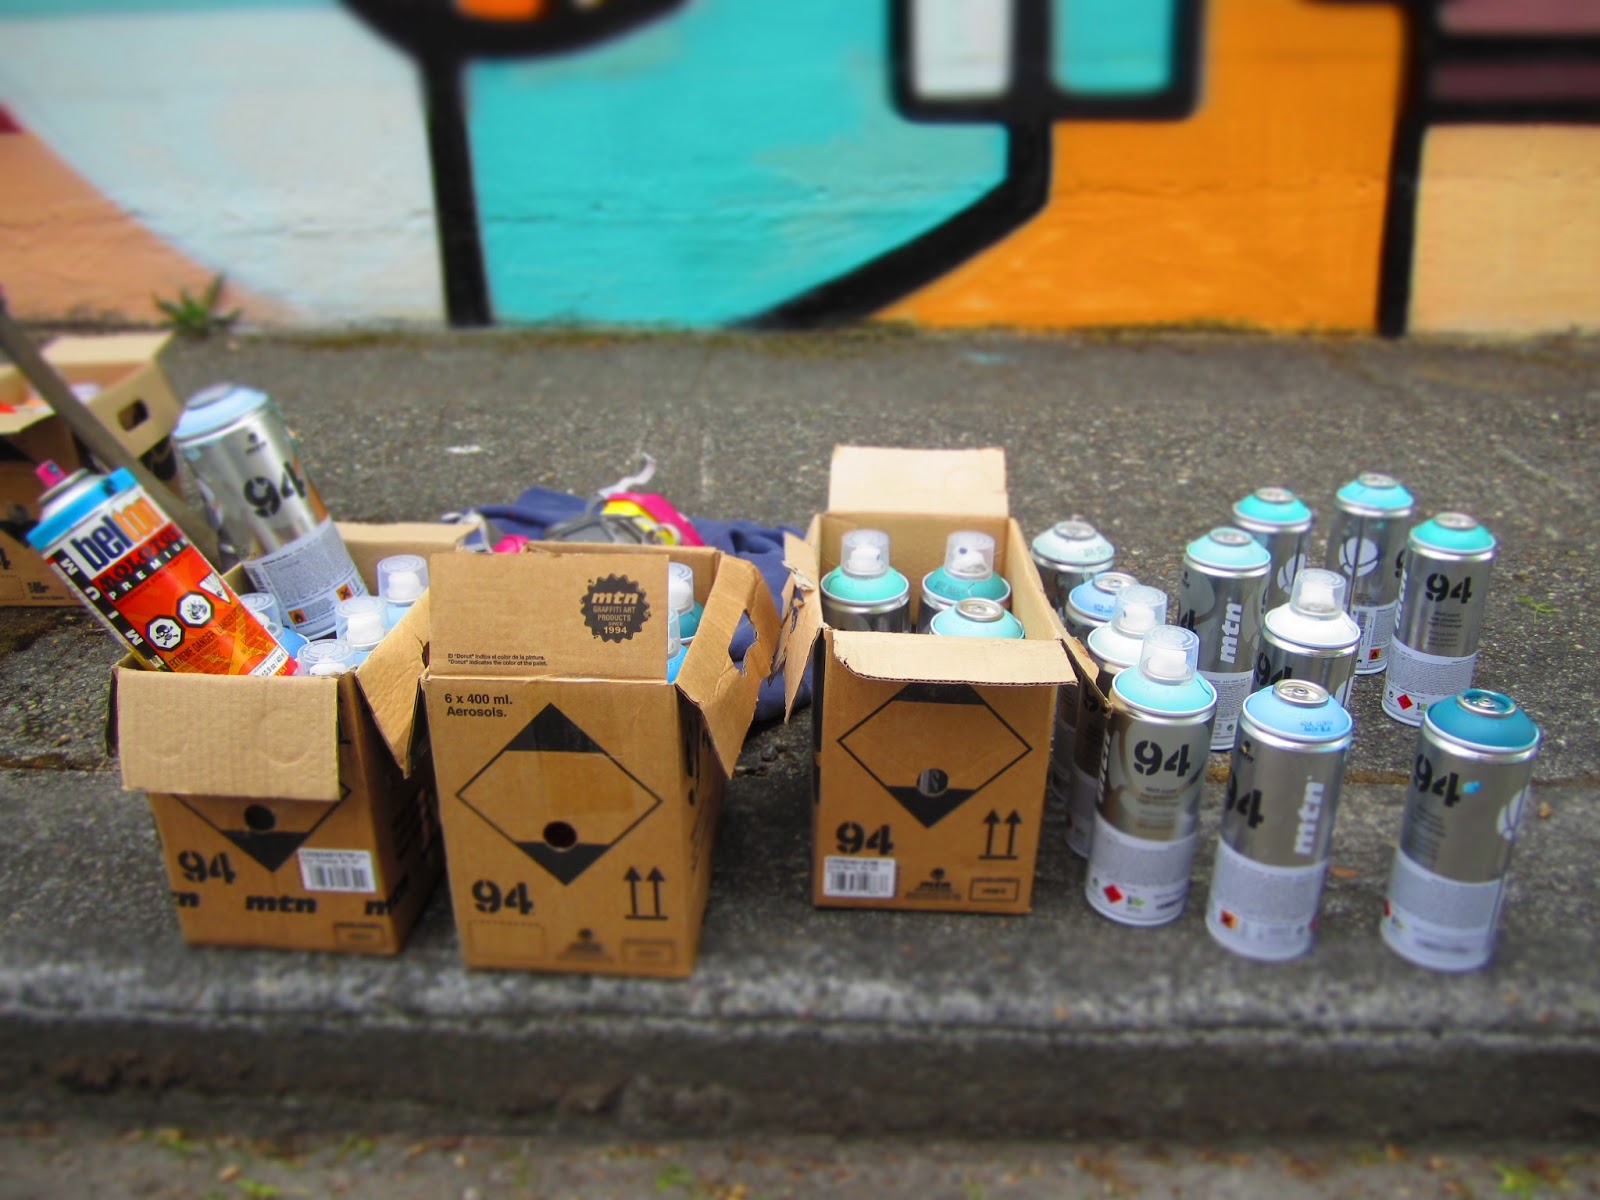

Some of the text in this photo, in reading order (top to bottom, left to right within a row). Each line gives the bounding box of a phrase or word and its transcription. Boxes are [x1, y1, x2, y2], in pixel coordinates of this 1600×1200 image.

[244, 461, 306, 518] 94
[591, 591, 639, 604] mtn
[1425, 573, 1472, 604] 94
[592, 605, 622, 613] GRAFFITI
[597, 614, 632, 622] PRODUCTS
[603, 626, 627, 634] 1994
[1220, 602, 1242, 664] mtn
[169, 644, 194, 669] EXTREME
[193, 629, 218, 655] DANGER
[444, 693, 513, 705] 6 x 400 ml.
[447, 706, 507, 717] Aerosols.
[1134, 740, 1190, 777] 94
[1413, 753, 1461, 808] 94
[1294, 781, 1325, 856] mtn
[836, 821, 894, 855] 94
[178, 850, 236, 885] 94
[246, 893, 318, 915] mtn
[472, 879, 534, 915] 94
